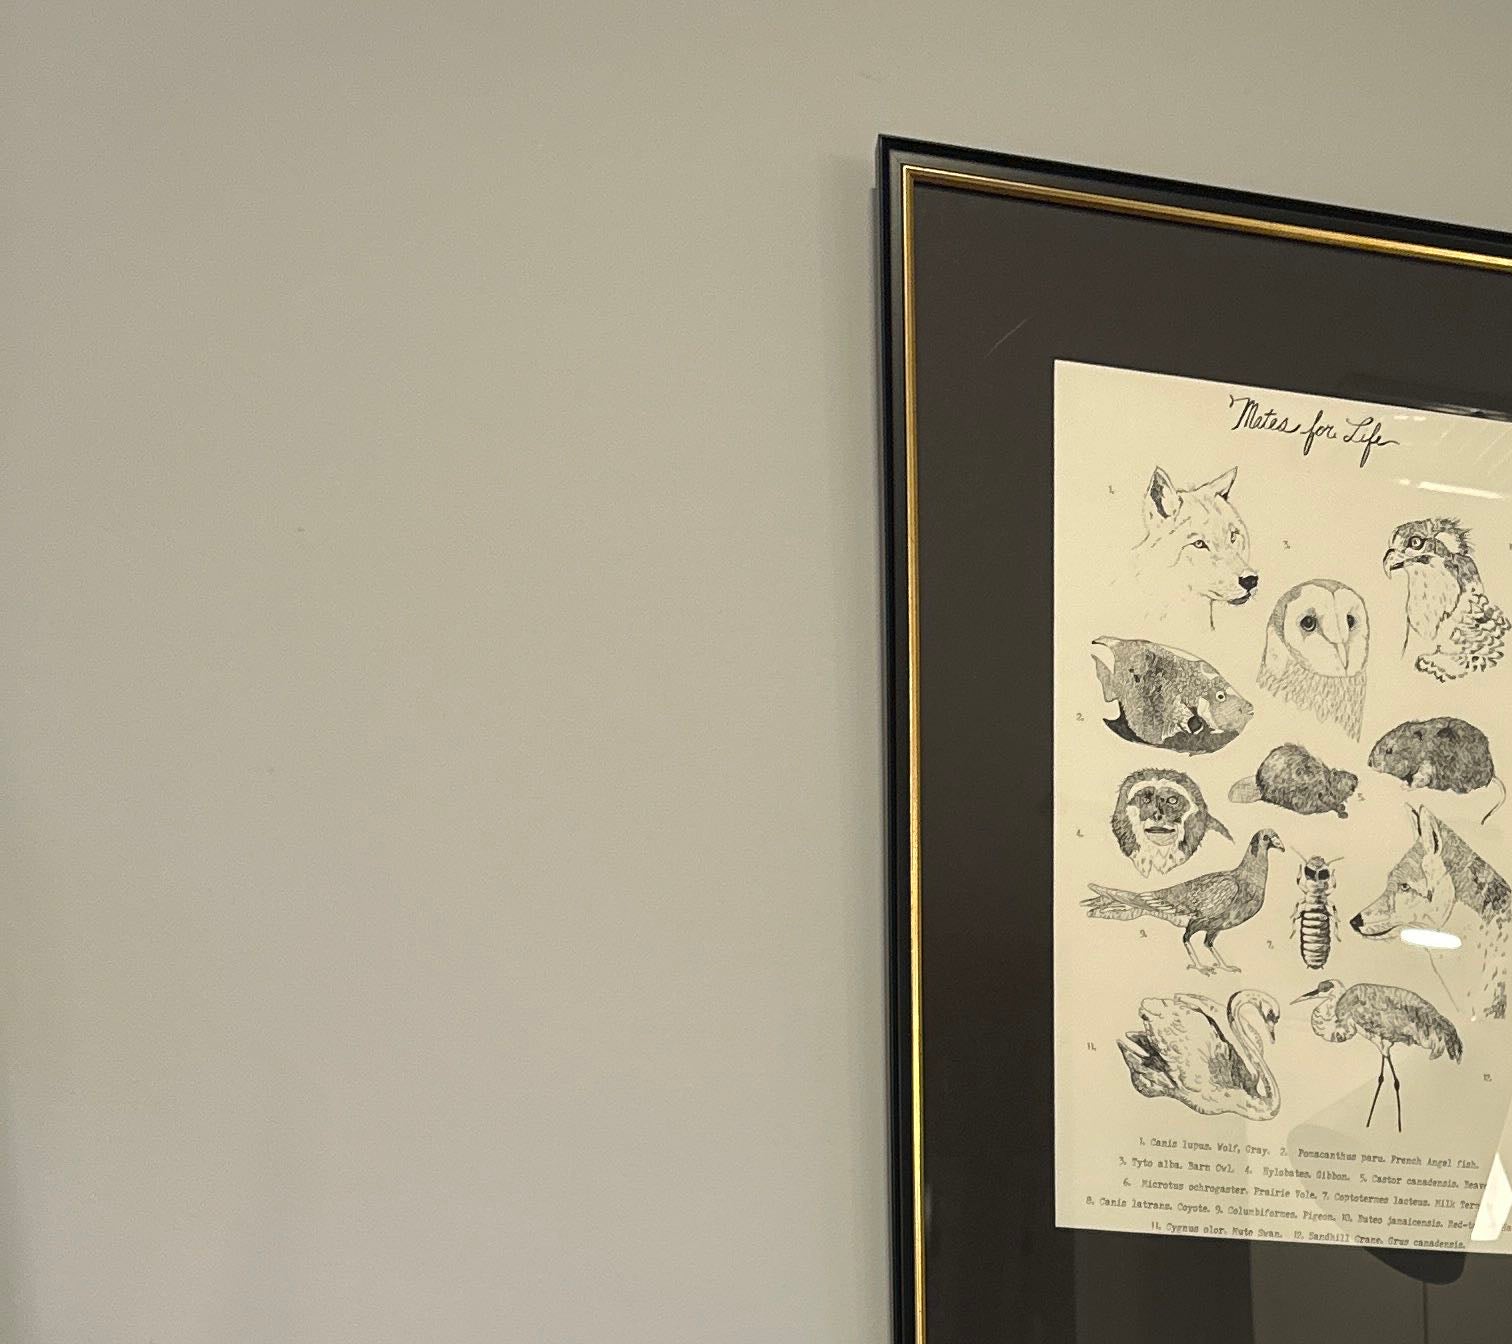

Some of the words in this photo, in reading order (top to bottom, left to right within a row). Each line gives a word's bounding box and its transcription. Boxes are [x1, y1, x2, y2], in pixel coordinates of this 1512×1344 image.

[1229, 394, 1301, 433] Mates
[1300, 410, 1336, 456] for
[1343, 416, 1400, 468] Life
[1150, 1138, 1177, 1148] Canis
[1182, 1140, 1212, 1151] lupus.
[1217, 1142, 1240, 1154] Wolf,
[1390, 1155, 1422, 1166] French
[1427, 1157, 1452, 1169] Angel
[1456, 1159, 1480, 1170] fish.
[1132, 1158, 1152, 1168] Tyto
[1157, 1160, 1182, 1170] alba.
[1188, 1161, 1210, 1172] Barn
[1372, 1175, 1402, 1185] Castor
[1142, 1180, 1184, 1190] Microtus
[1254, 1186, 1290, 1198] Prairie
[1295, 1190, 1318, 1200] Vole.
[1434, 1199, 1456, 1209] Milk
[1099, 1198, 1127, 1208] Canis
[1132, 1199, 1173, 1210] latrans.
[1177, 1202, 1210, 1214] Coyote.
[1302, 1211, 1336, 1222] Pigeon.
[1166, 1223, 1199, 1234] Cygnus
[1232, 1227, 1253, 1236] Mute
[1257, 1228, 1282, 1238] Swan.
[1309, 1232, 1350, 1242] Sandhill
[1388, 1236, 1410, 1246] Grus
